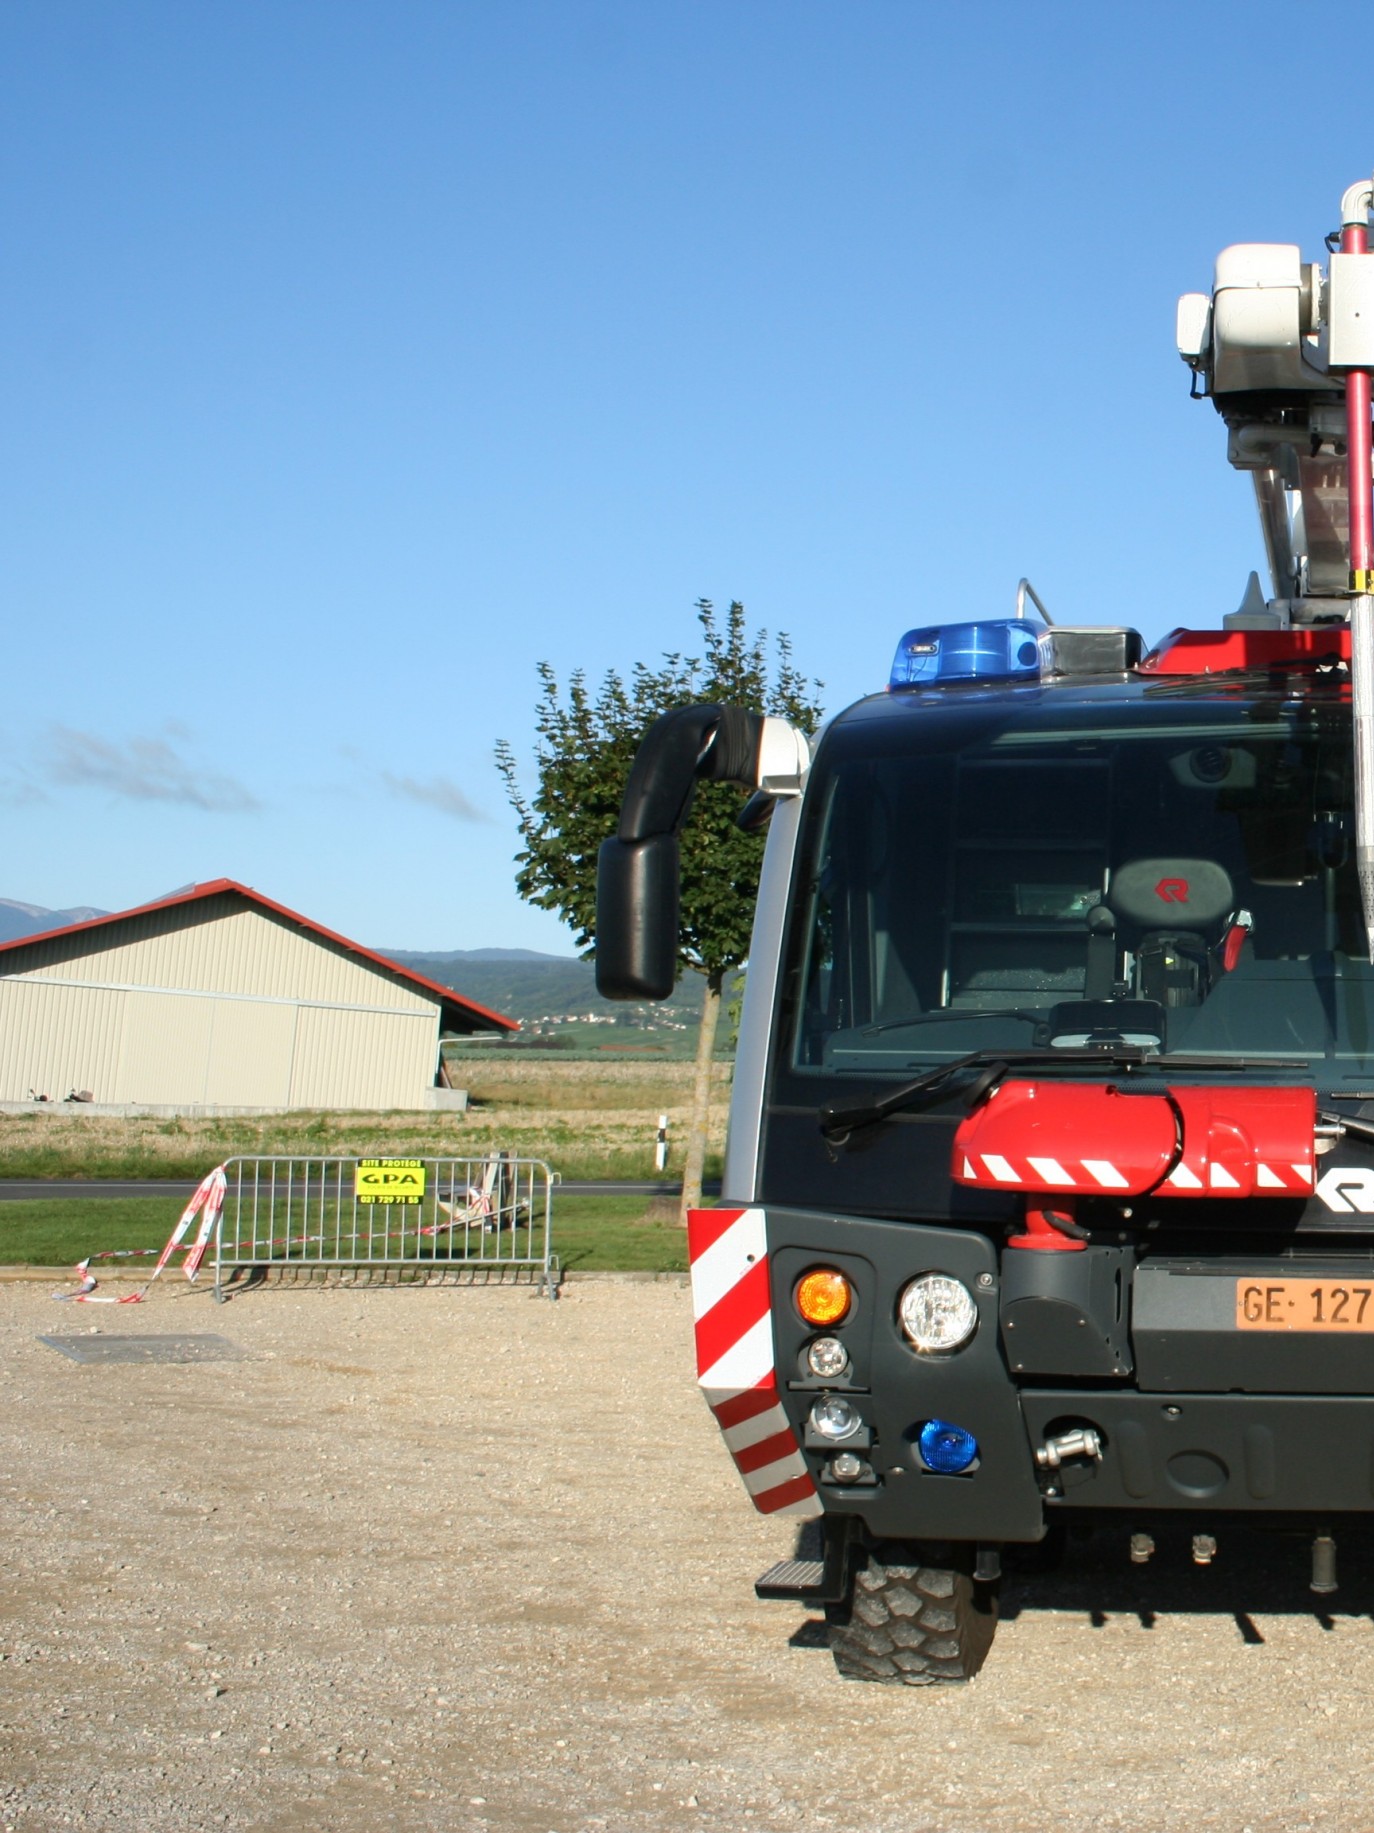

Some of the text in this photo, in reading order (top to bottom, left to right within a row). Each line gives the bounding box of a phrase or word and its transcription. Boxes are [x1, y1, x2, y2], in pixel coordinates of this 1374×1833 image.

[361, 1159, 380, 1167] SITE
[361, 1173, 420, 1185] GPA
[360, 1195, 376, 1204] 021
[378, 1195, 395, 1204] 729
[396, 1195, 406, 1204] 71
